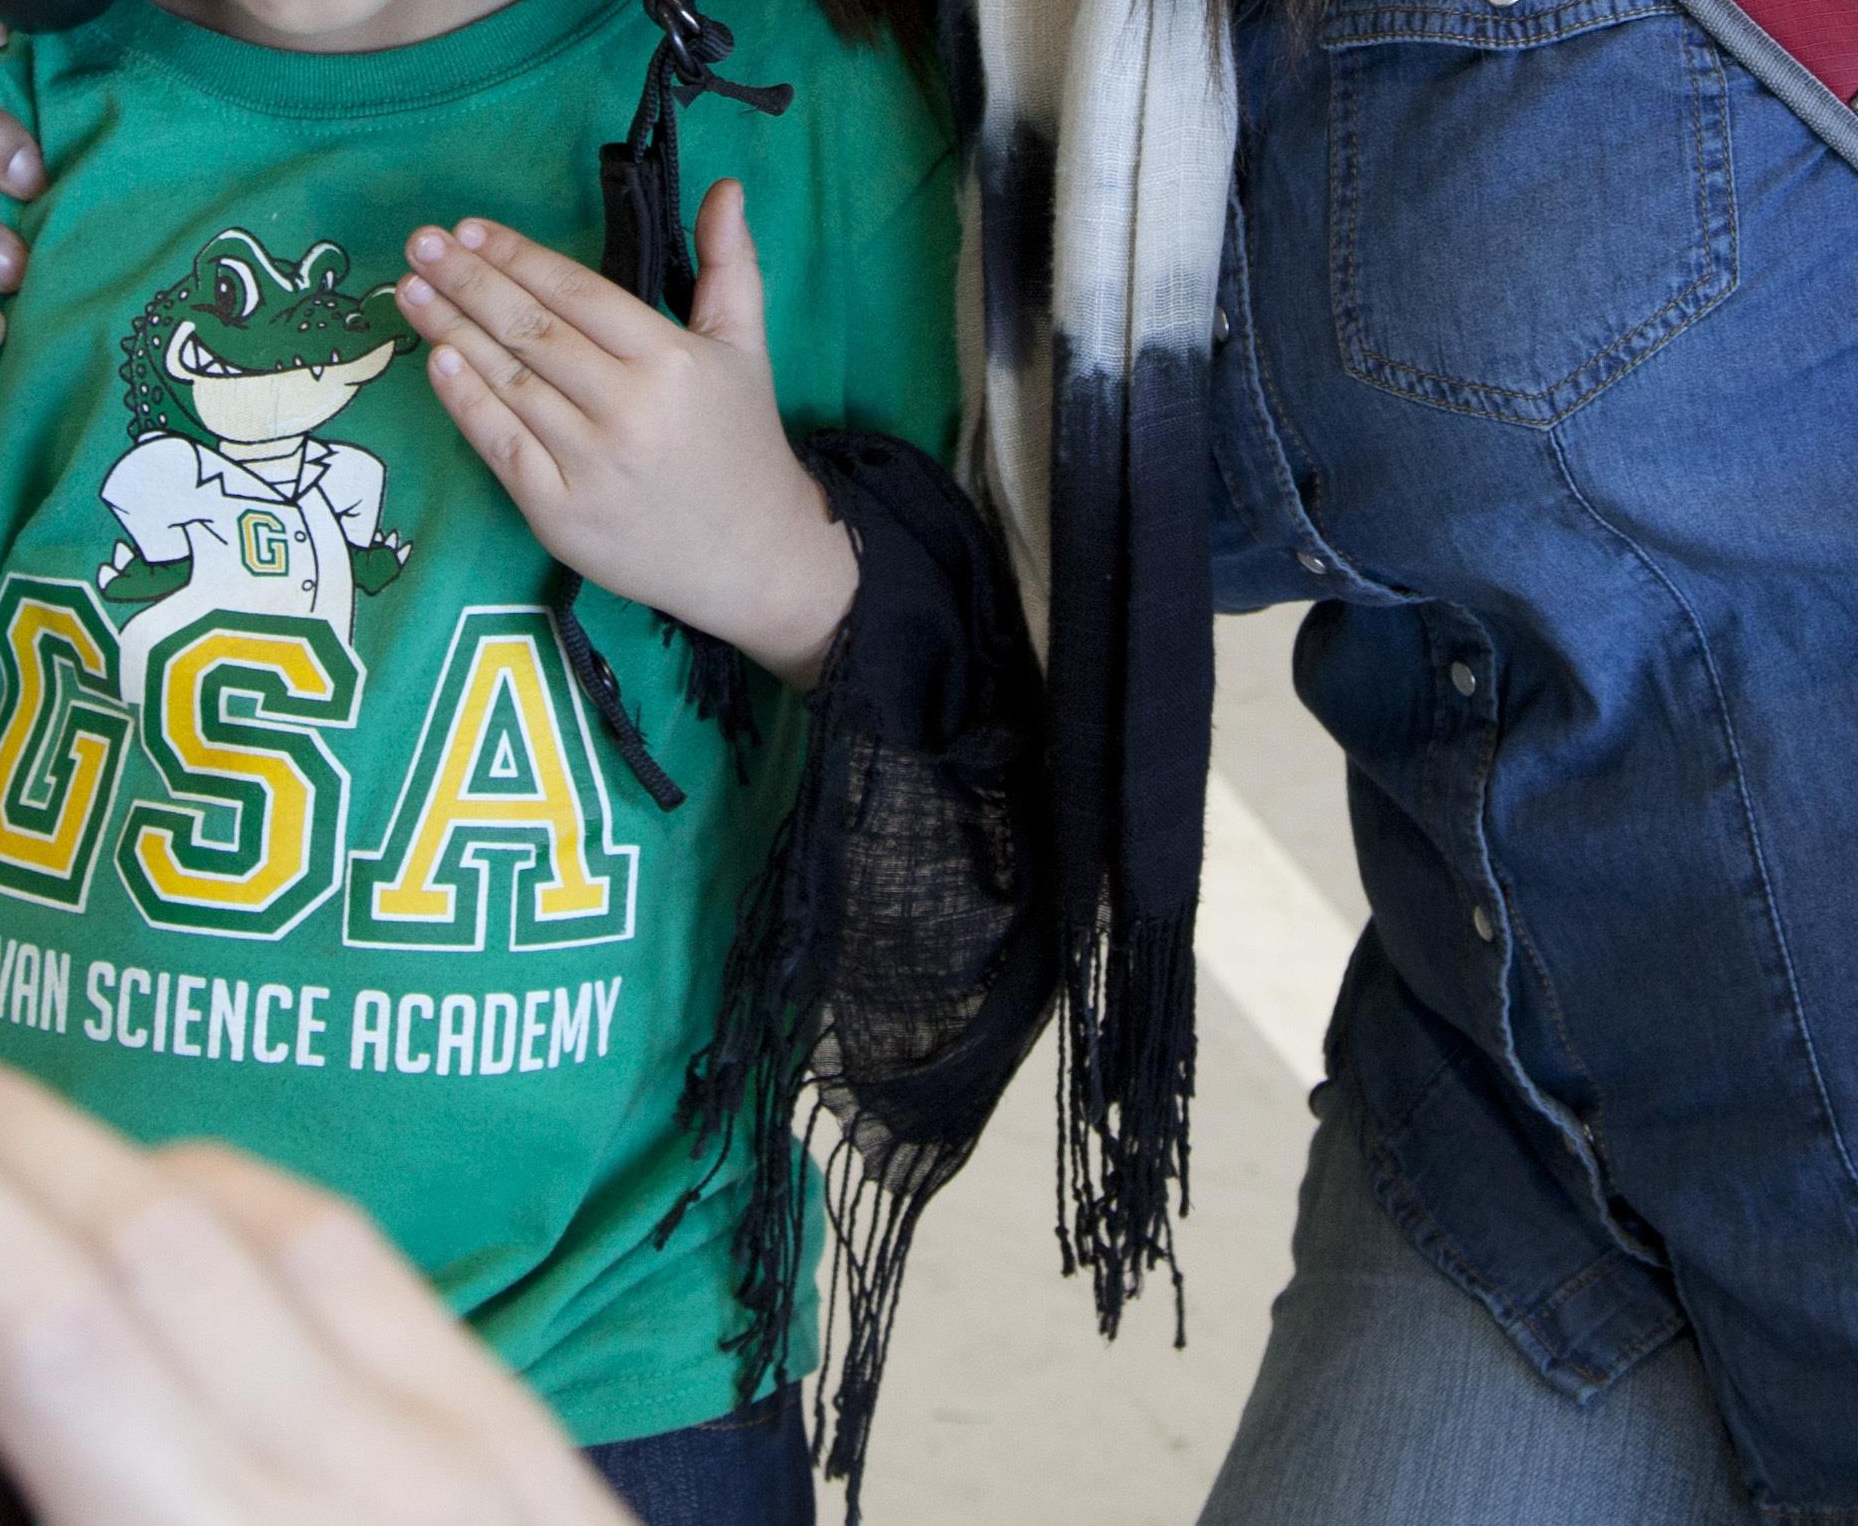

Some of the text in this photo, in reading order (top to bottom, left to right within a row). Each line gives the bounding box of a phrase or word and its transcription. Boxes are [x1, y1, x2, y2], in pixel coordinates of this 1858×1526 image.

[237, 508, 290, 577] G
[84, 961, 330, 1067] SCIENCE
[350, 976, 623, 1076] ACADEMY
